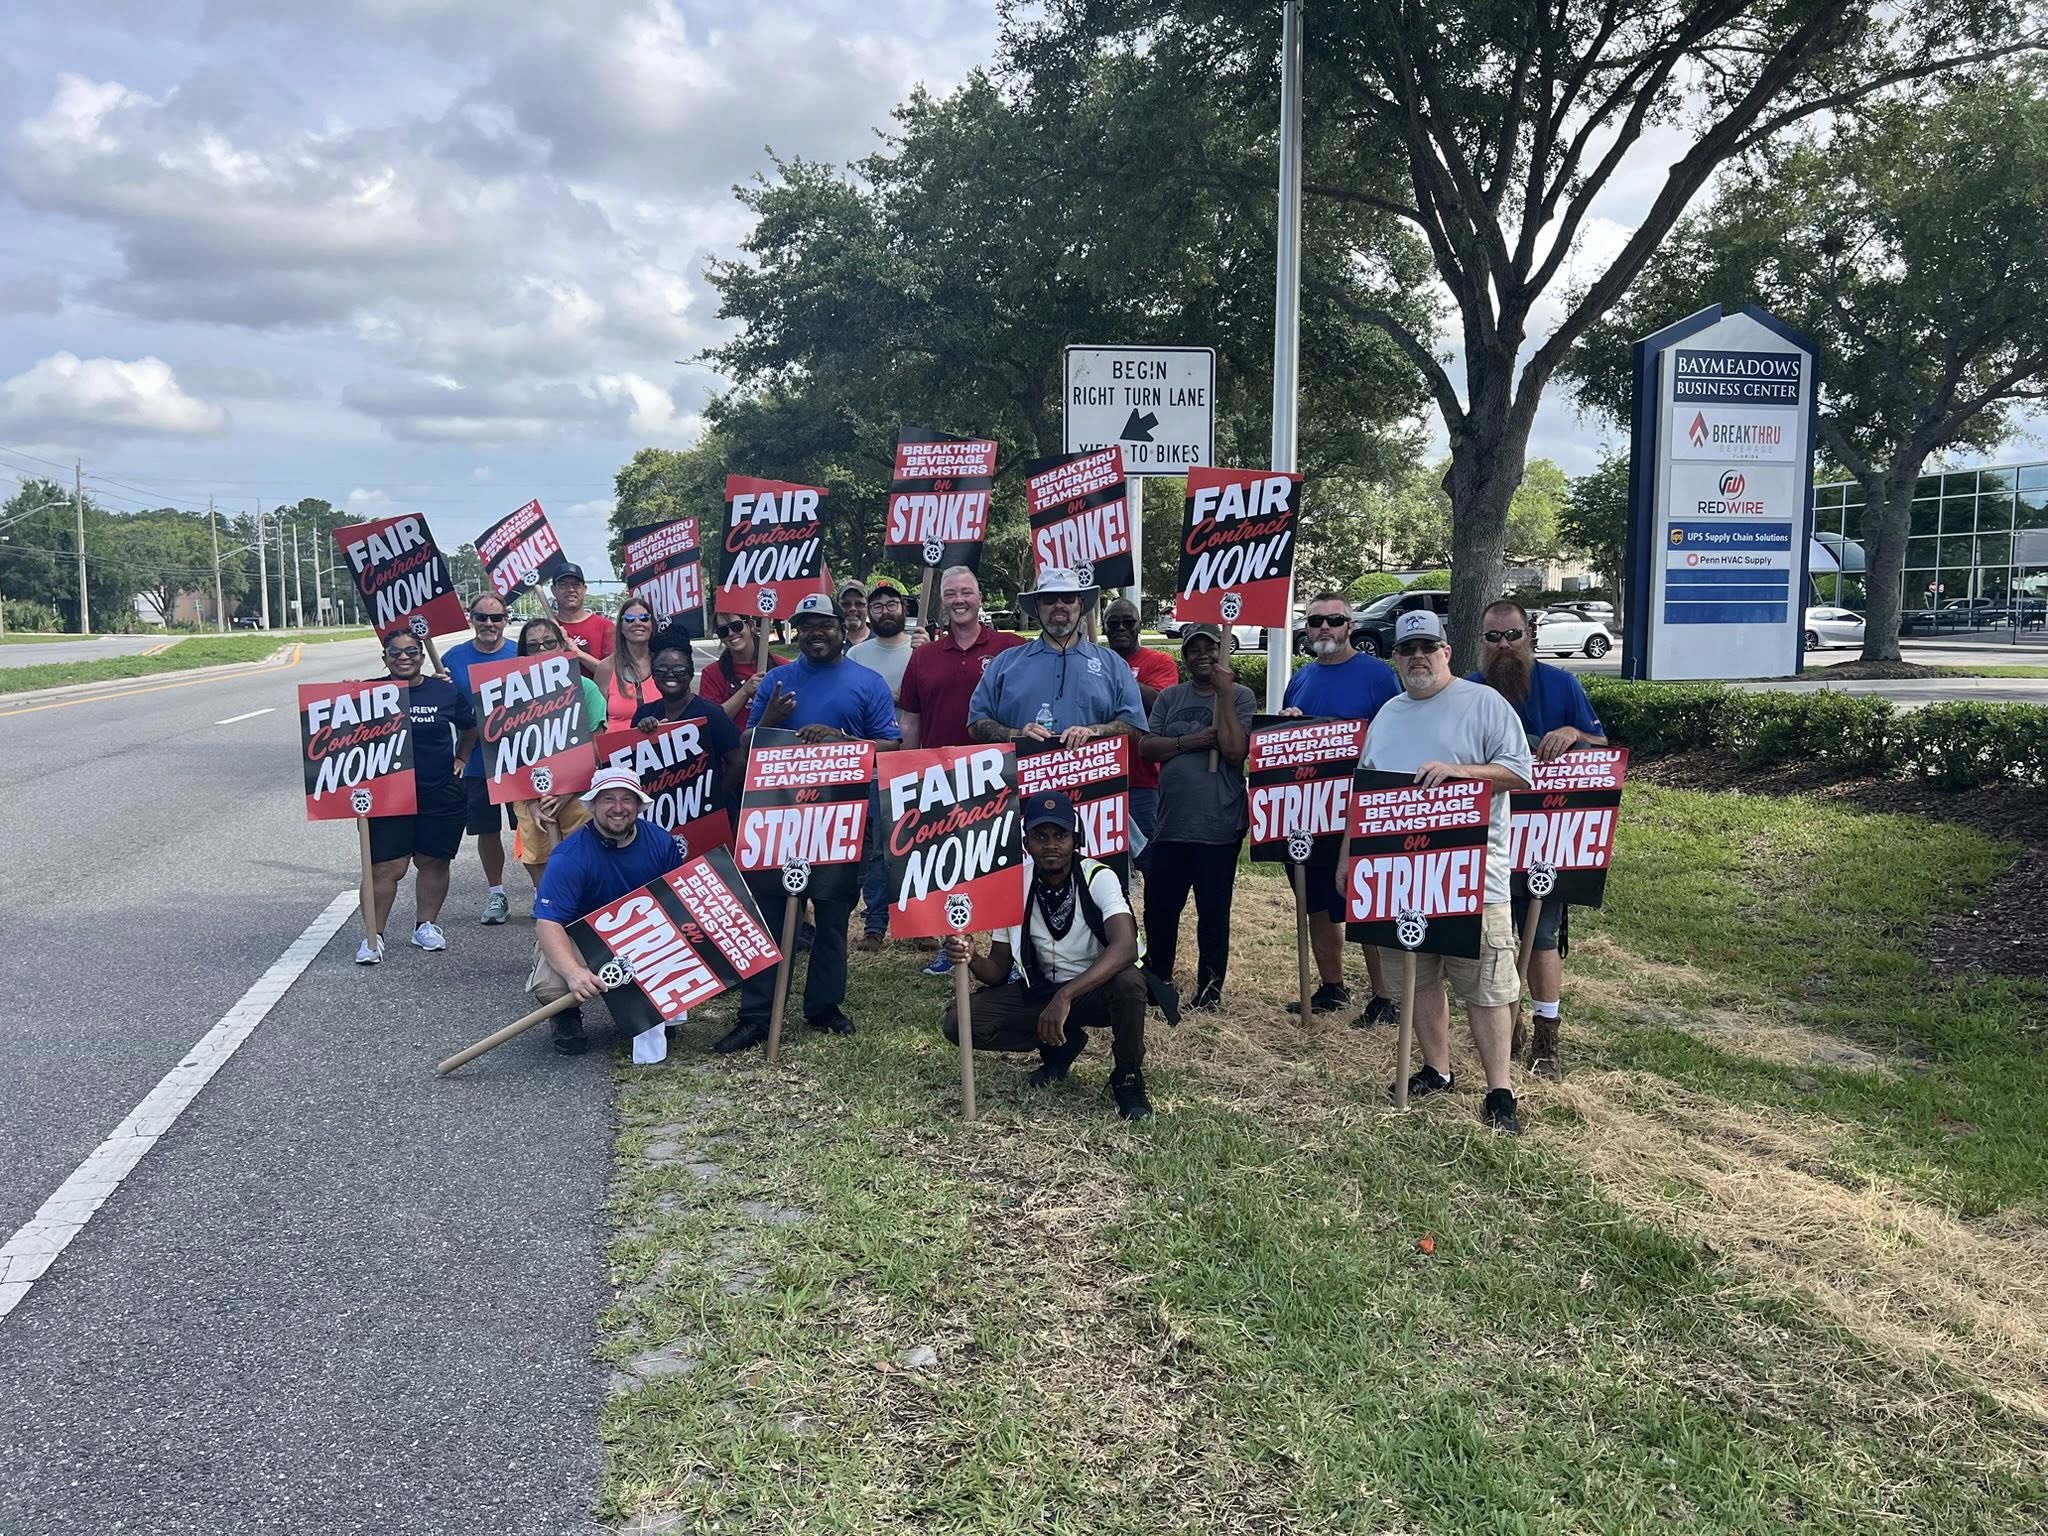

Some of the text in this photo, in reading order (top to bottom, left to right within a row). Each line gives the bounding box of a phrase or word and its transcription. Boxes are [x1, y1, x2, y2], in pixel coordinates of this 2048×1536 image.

[1112, 360, 1168, 380] BEGIN
[1677, 357, 1800, 377] BAYMEADOWS
[1073, 386, 1206, 407] RIGHT TURN LANE
[1676, 381, 1798, 398] BUSINESS CENTER
[902, 443, 992, 456] BREAKTHRU
[1712, 424, 1781, 445] BREAKTHRU
[901, 464, 988, 477] TEAMSTERS
[906, 454, 985, 466] BEVERAGE
[1030, 449, 1117, 489] BREAKTHRU
[1130, 444, 1148, 463] TO
[1156, 445, 1200, 464] BIKES
[934, 479, 953, 491] on
[1033, 471, 1119, 510] TEAMSTERS
[1037, 462, 1113, 498] BEVERAGE
[730, 489, 820, 527] FAIR
[890, 492, 986, 543] STRIKE!
[1067, 499, 1087, 514] on
[1192, 475, 1292, 526] FAIR
[1697, 501, 1764, 515] REDWIRE
[480, 502, 536, 553] BREAKTHRU
[485, 510, 535, 555] BEVERAGE
[485, 513, 541, 562] TEAMSTERS
[627, 519, 694, 554] BREAKTHRU
[725, 520, 821, 553] Contract
[1036, 500, 1127, 574] STRIKE!
[1185, 510, 1294, 555] Contract
[1687, 532, 1703, 541] UPS
[1705, 532, 1731, 543] Supply
[1732, 532, 1751, 541] Chain
[1755, 533, 1789, 542] Solutions
[346, 516, 426, 574] FAIR
[492, 522, 558, 596] STRIKE!
[630, 538, 695, 572] TEAMSTERS
[631, 530, 690, 562] BEVERAGE
[1700, 556, 1772, 566] Penn HVAC Supply
[360, 541, 432, 595] Contract
[653, 561, 667, 575] on
[723, 537, 820, 593] NOW!
[1183, 530, 1292, 601] NOW!
[376, 556, 443, 630] NOW!
[480, 656, 573, 717] FAIR
[307, 683, 401, 735] FAIR
[410, 706, 438, 714] REW
[410, 715, 435, 723] You!
[484, 683, 578, 743] Contract
[307, 711, 406, 761] Contract
[494, 702, 581, 784] NOW!
[1255, 721, 1362, 746] BREAKTHRU
[1261, 734, 1354, 757] BEVERAGE
[313, 729, 408, 801] NOW!
[755, 743, 869, 762] BREAKTHRU
[760, 756, 861, 775] BEVERAGE
[1017, 737, 1122, 771] BREAKTHRU
[1023, 752, 1116, 783] BEVERAGE
[1255, 746, 1359, 769] TEAMSTERS
[641, 751, 710, 794] ontract
[753, 769, 865, 788] TEAMSTERS
[889, 748, 1007, 822] FAIR
[1018, 763, 1121, 796] TEAMSTERS
[1294, 765, 1318, 780] on
[795, 788, 820, 803] on
[1252, 777, 1354, 842] STRIKE
[1358, 781, 1484, 807] BREAKTHRU
[1364, 797, 1475, 821] BEVERAGE
[1542, 794, 1569, 809] on
[740, 803, 863, 869] STRIKE!
[890, 785, 1012, 857] Contract
[1358, 811, 1481, 834] TEAMSTERS
[1403, 834, 1431, 851] on
[1510, 810, 1613, 869] TRIKE!
[897, 810, 1015, 912] NOW!
[1351, 849, 1482, 921] STRIKE!
[671, 875, 751, 971] TEAMSTERS
[687, 874, 760, 961] BEVERAGE
[694, 862, 778, 959] BREAKTHRU
[680, 922, 704, 944] on
[594, 895, 720, 1013] STRIKE!
